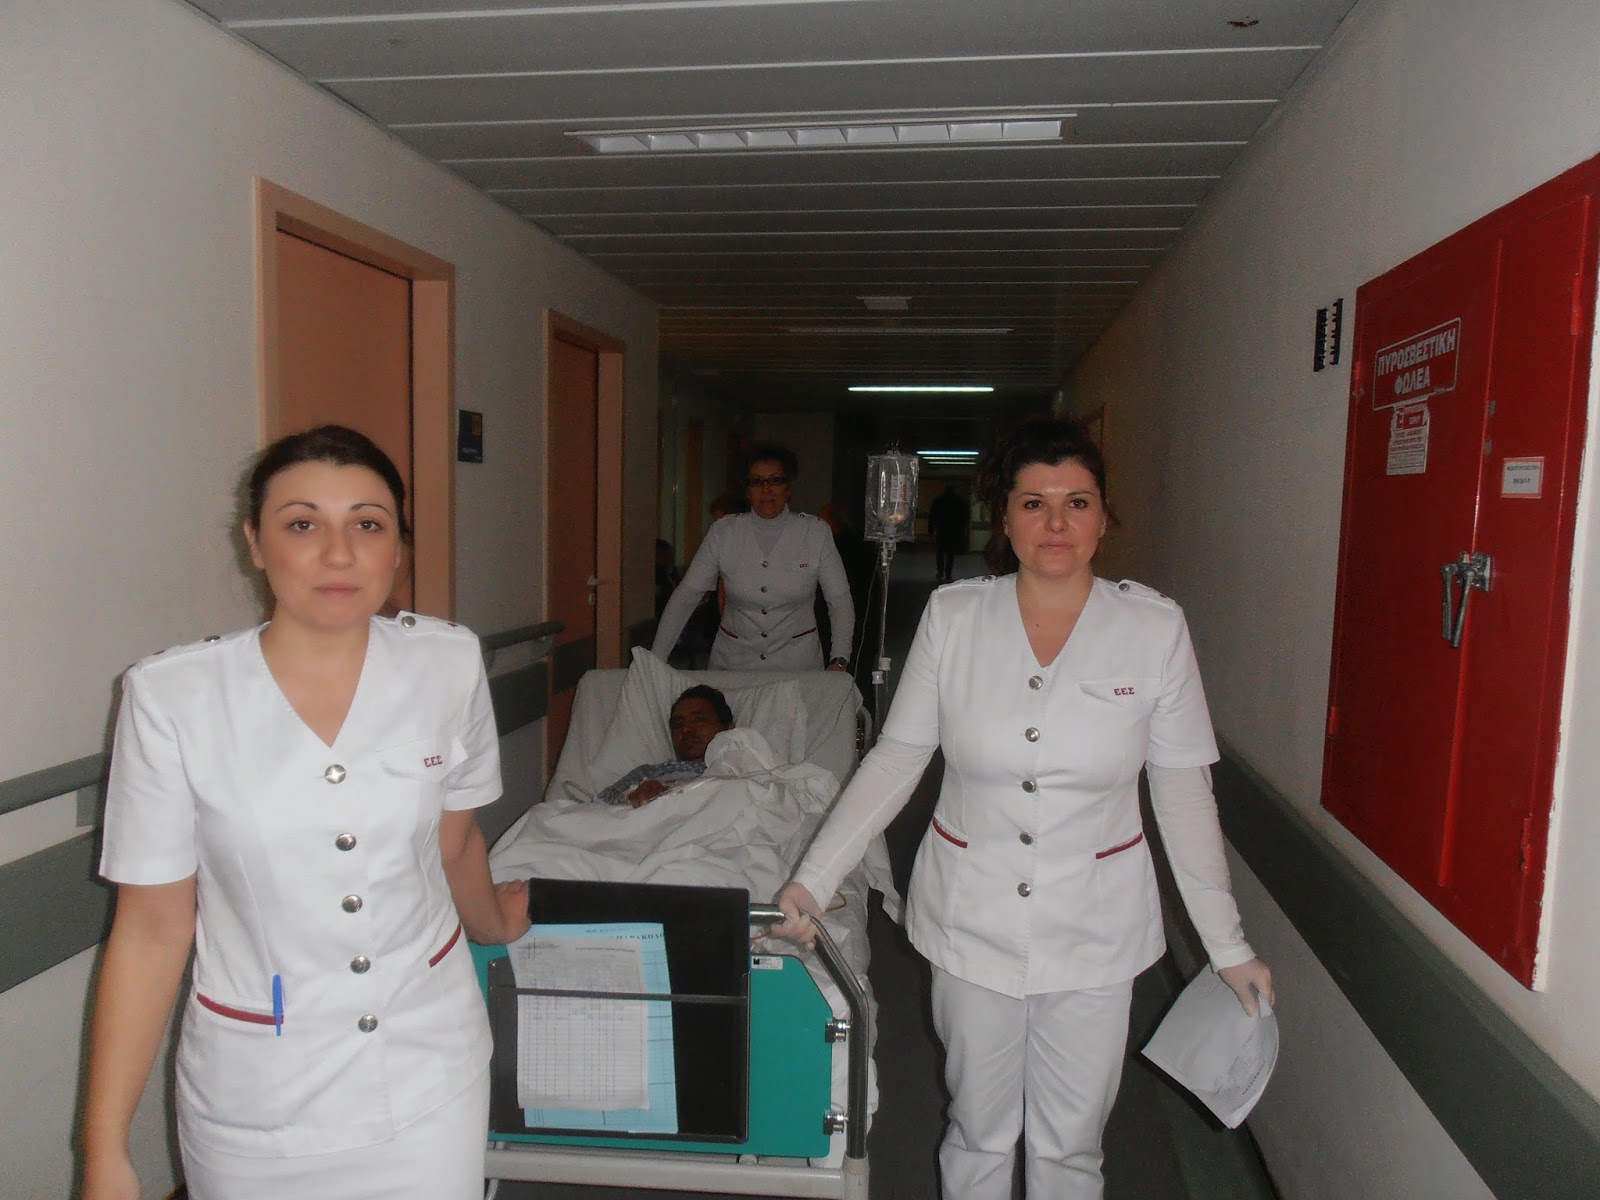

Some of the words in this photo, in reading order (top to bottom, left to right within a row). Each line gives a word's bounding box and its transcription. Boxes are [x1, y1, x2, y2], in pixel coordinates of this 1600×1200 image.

[1377, 327, 1456, 377] ΠΥΡΟΣΒΕΣΤΙΚΗ
[1394, 365, 1431, 395] ΦΩΛΕΑ
[1113, 687, 1135, 696] ΕΕΣ
